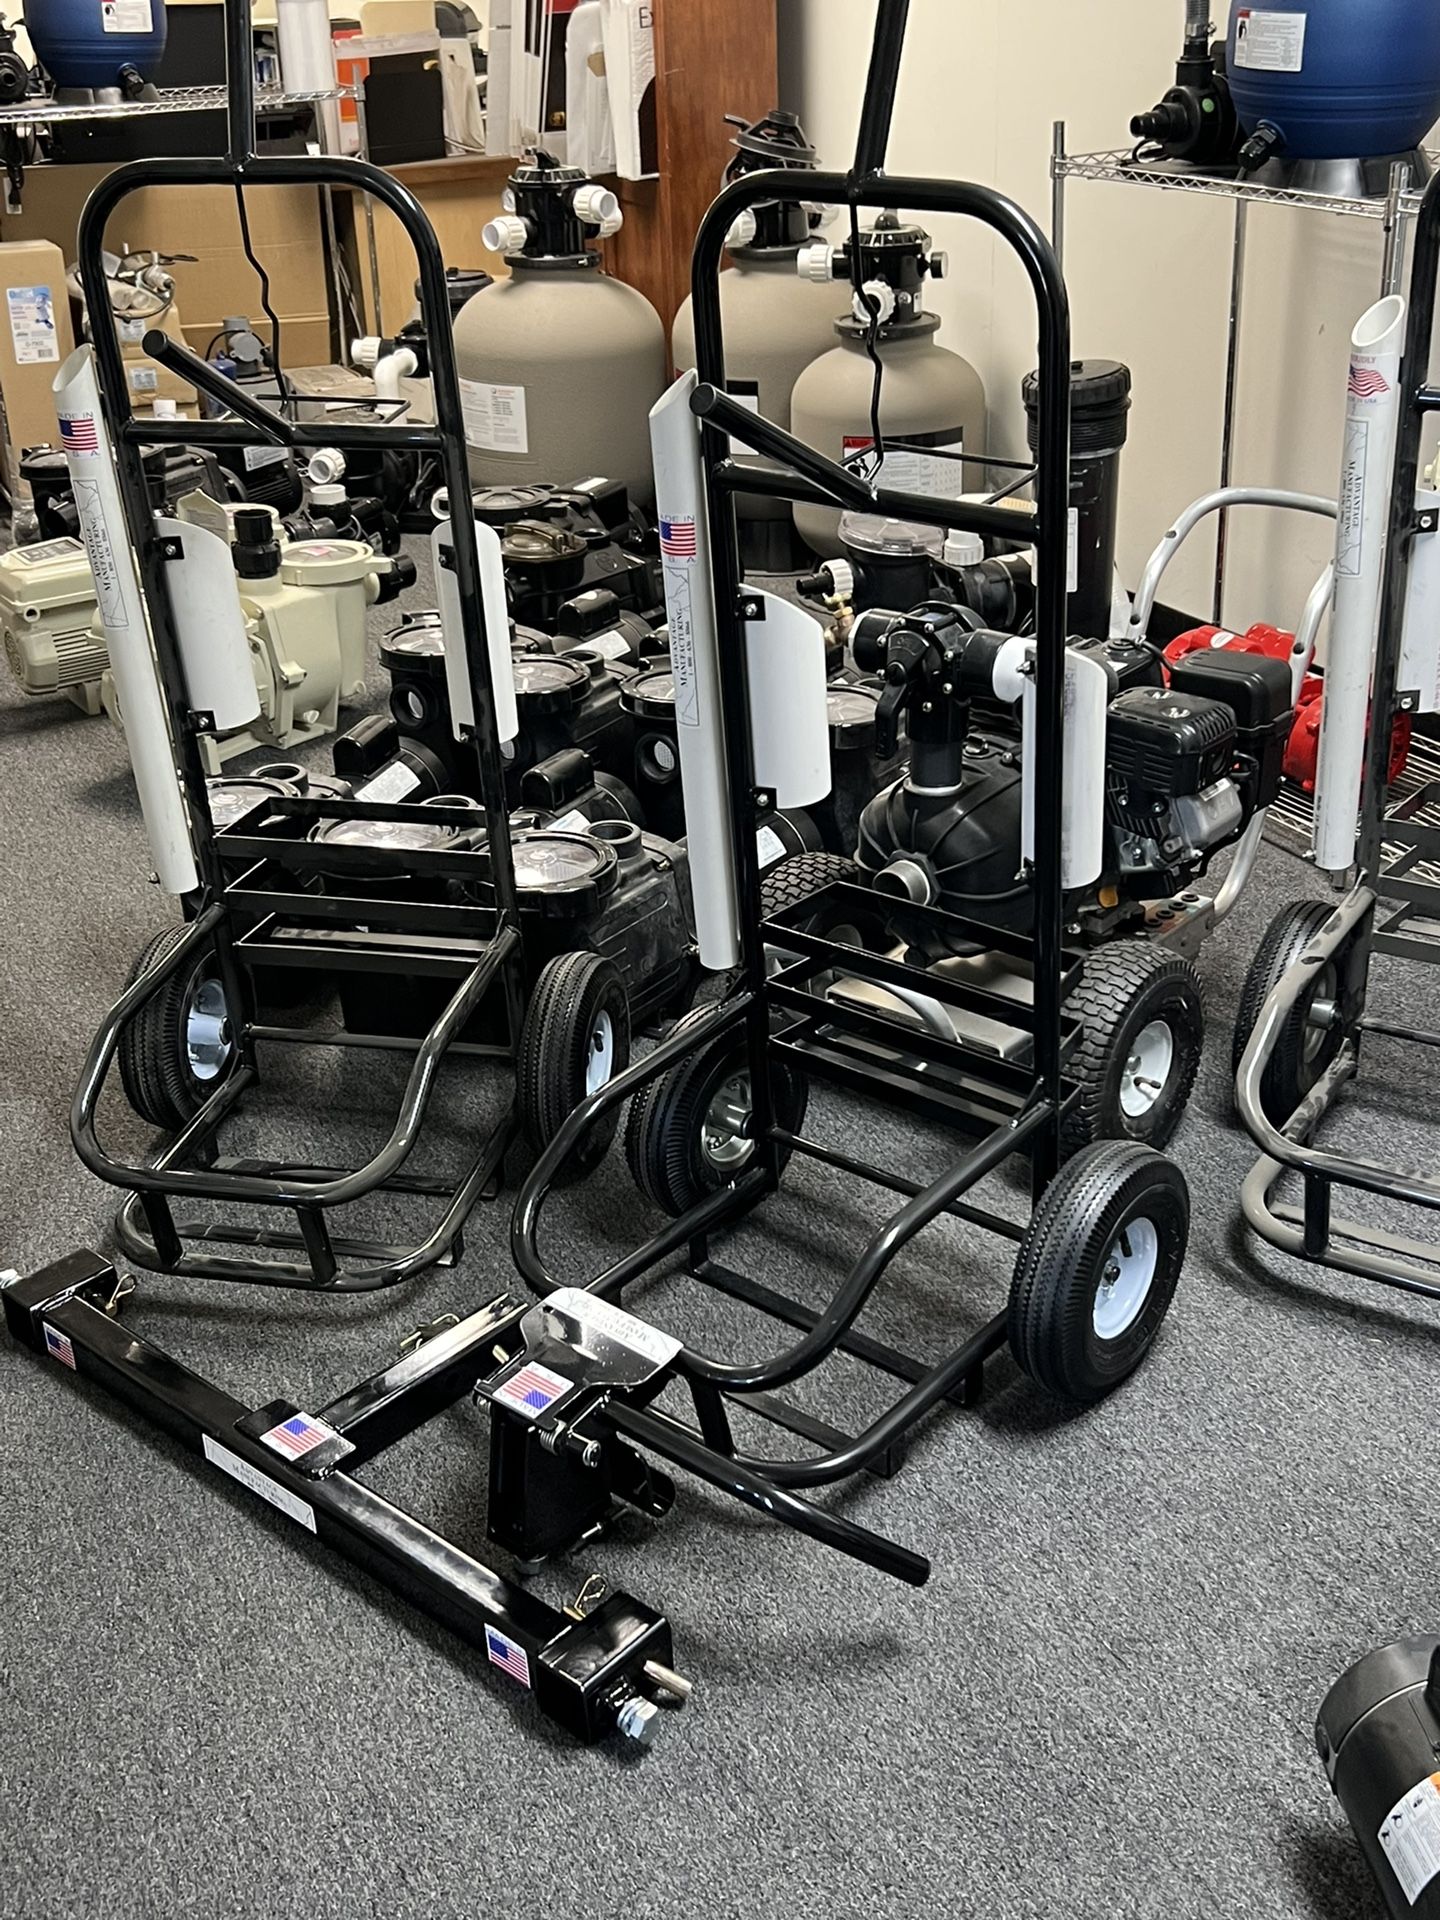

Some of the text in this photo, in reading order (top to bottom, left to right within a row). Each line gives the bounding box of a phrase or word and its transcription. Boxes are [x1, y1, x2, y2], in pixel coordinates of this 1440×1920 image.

[1344, 460, 1356, 538] MANUFACTURING
[1351, 475, 1363, 528] ADVANTAGE
[86, 528, 102, 580] ADVANTAGE
[91, 518, 112, 592] MANUFACTURING
[671, 618, 680, 673] ADVANTAGE
[676, 608, 688, 687] MANUFACTURING
